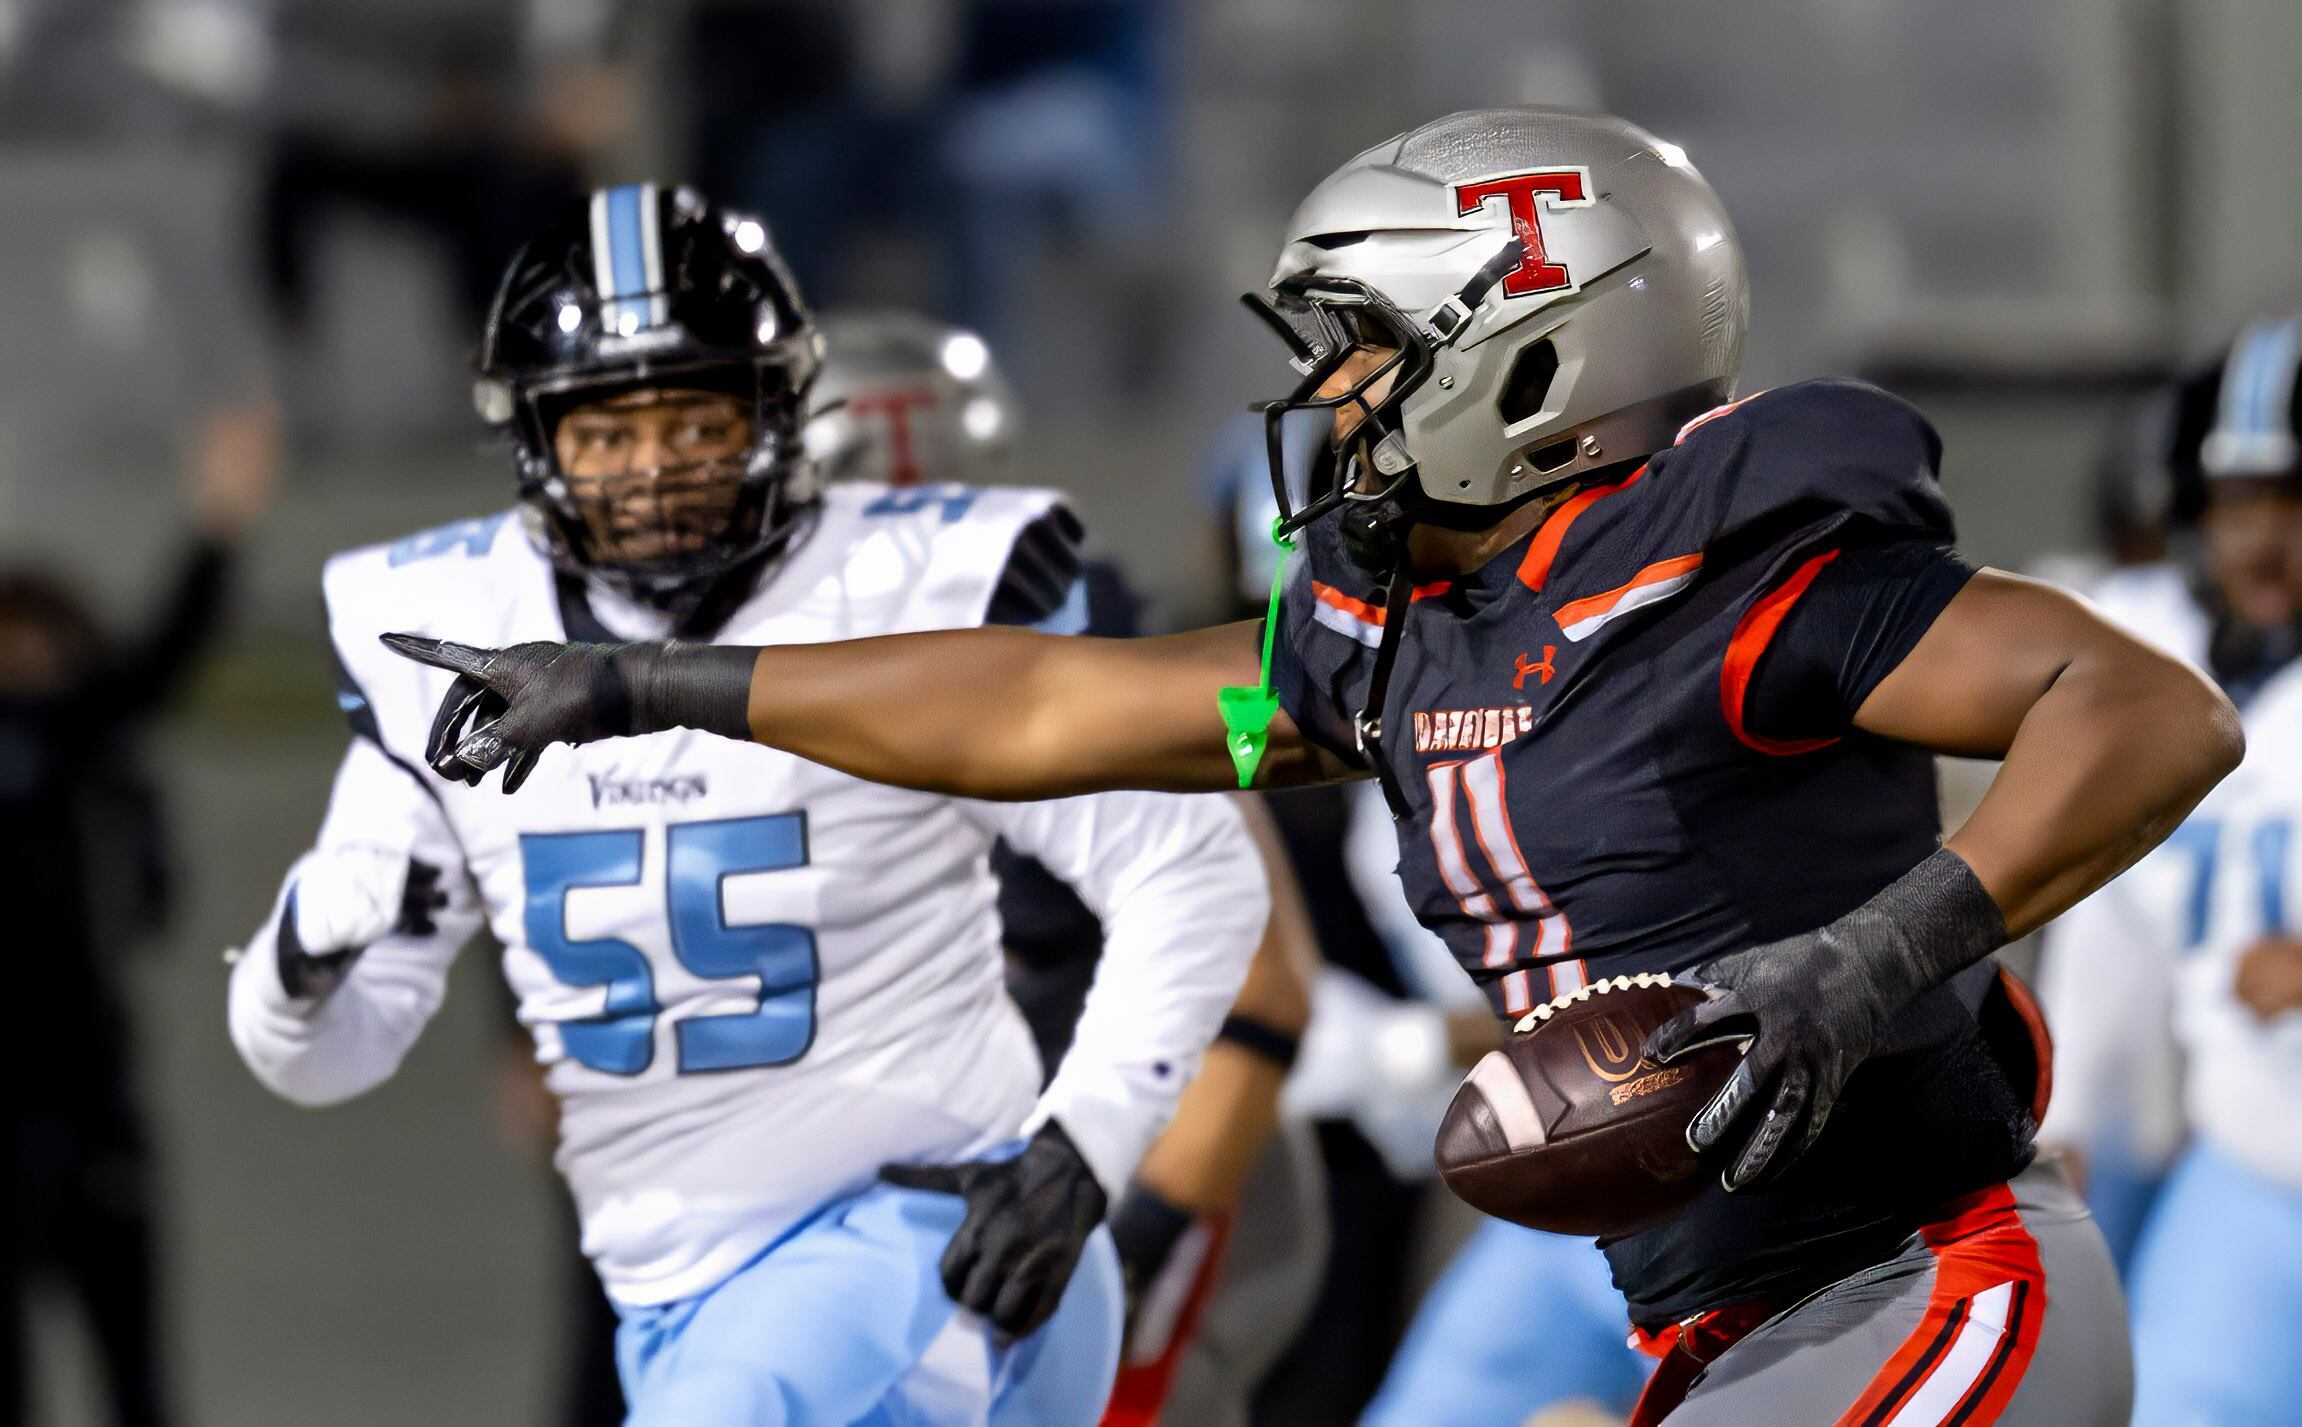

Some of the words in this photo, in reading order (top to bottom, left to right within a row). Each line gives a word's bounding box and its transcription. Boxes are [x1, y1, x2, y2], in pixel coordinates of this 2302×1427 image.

[1455, 171, 1587, 300] T
[848, 389, 938, 486] T
[519, 808, 820, 1076] 55
[1427, 746, 1588, 1016] 11
